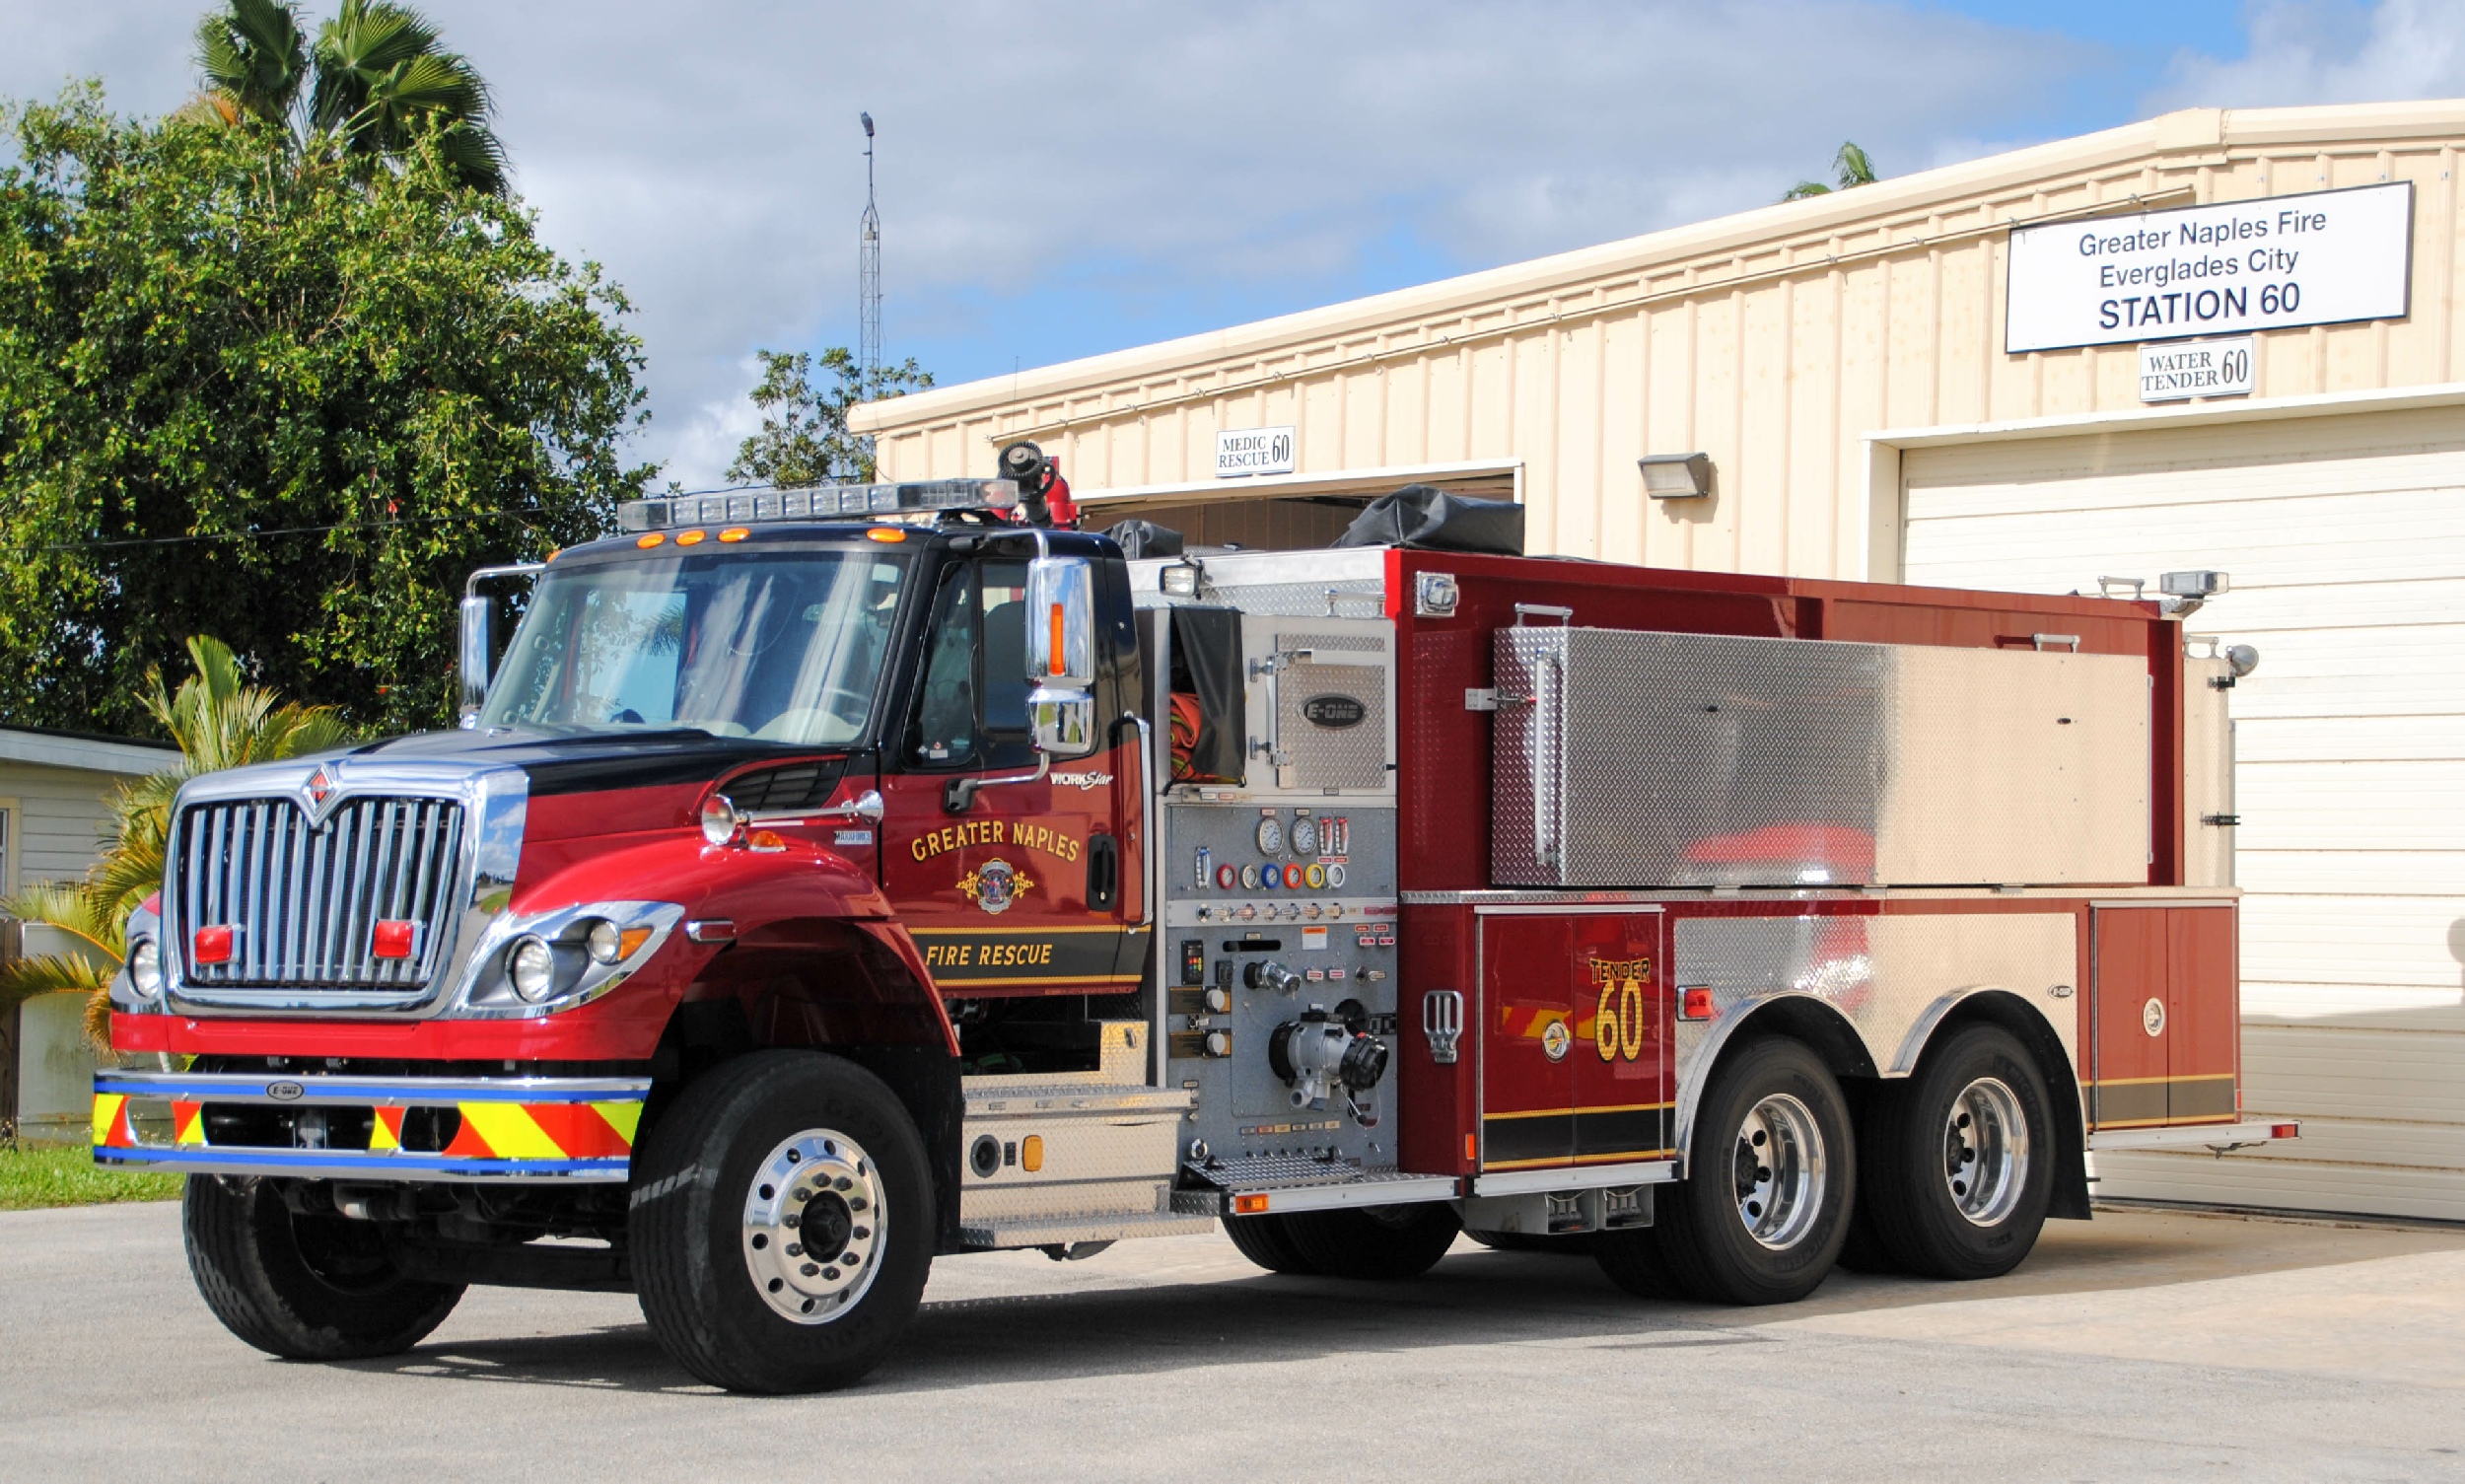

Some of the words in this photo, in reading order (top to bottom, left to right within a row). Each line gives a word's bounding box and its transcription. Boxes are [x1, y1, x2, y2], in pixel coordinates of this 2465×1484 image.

[2078, 228, 2172, 257] Greater
[2180, 217, 2269, 247] Naples
[2278, 210, 2327, 235] Fire
[2099, 254, 2239, 289] Everglades
[2248, 248, 2299, 275] City
[2099, 286, 2249, 330] STATION
[2259, 282, 2301, 315] 60
[2148, 351, 2213, 373] WATER
[2221, 348, 2248, 385] 60
[2141, 371, 2219, 392] TENDER
[1223, 436, 1267, 453] MEDIC
[1272, 434, 1290, 463] 60
[1219, 452, 1269, 468] RESCUE
[1306, 703, 1359, 719] E-ONE
[911, 820, 1004, 862] GREATER
[1013, 822, 1080, 862] NAPLES
[925, 945, 971, 966] FIRE
[978, 944, 1053, 965] RESCUE
[1589, 956, 1651, 984] TENDER
[1596, 978, 1644, 1063] 60
